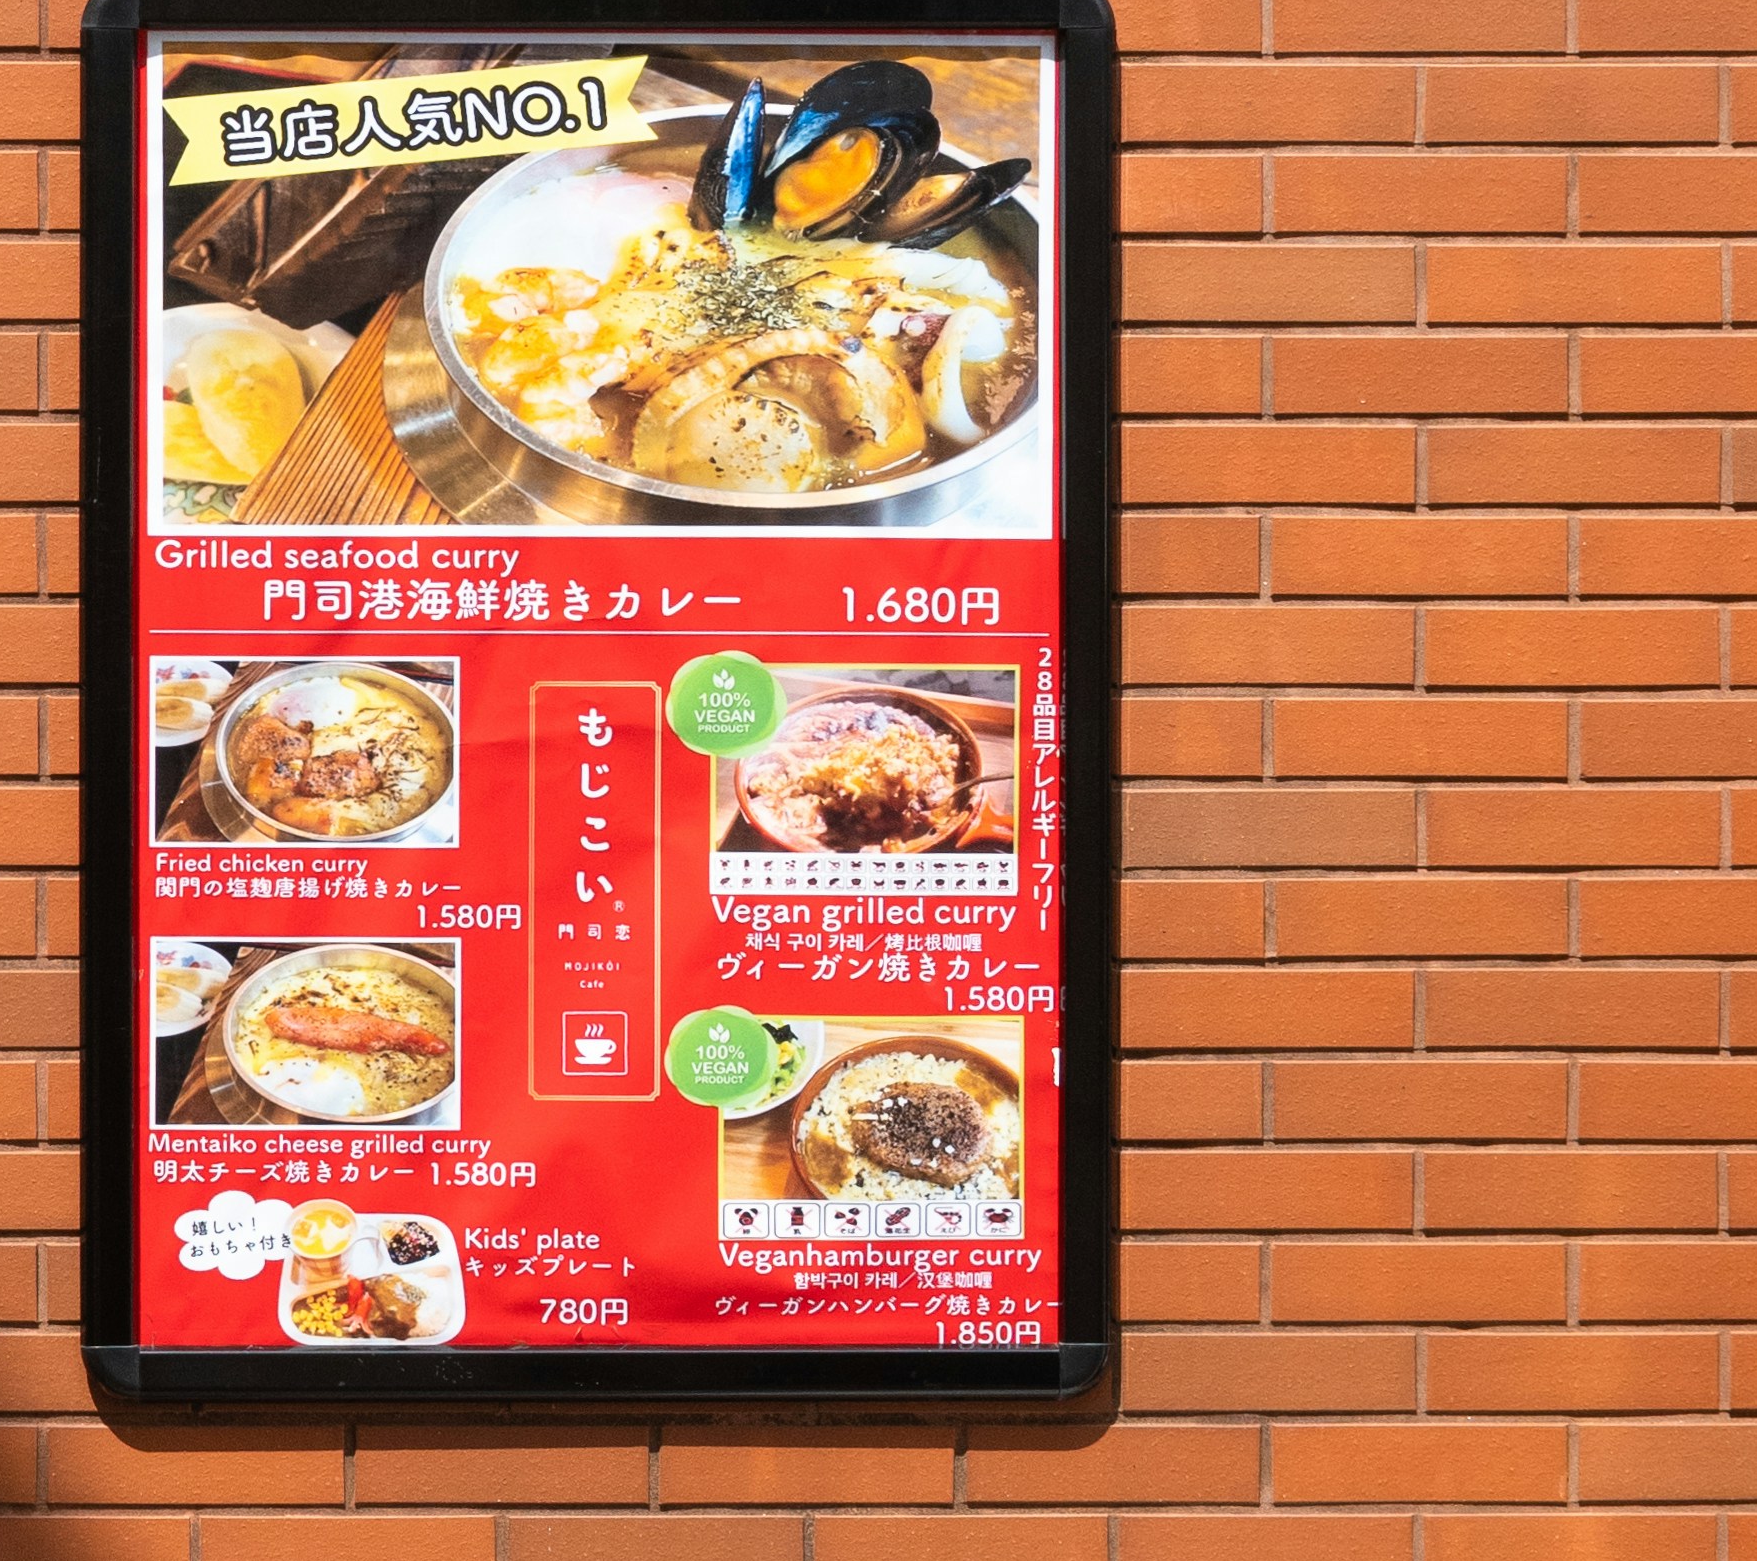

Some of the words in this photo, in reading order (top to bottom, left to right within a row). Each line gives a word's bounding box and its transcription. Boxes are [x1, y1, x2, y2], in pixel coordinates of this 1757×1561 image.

[221, 76, 608, 166] 当店人気NO.1
[154, 540, 273, 569] Grilled
[284, 540, 419, 570] seafood
[432, 546, 520, 578] curry
[264, 578, 741, 621] 門司港海鮮焼きカレー
[843, 587, 999, 625] 1.680円
[699, 692, 751, 708] 100%
[694, 709, 755, 723] VEGAN
[697, 724, 750, 733] PRODUCT
[1031, 647, 1058, 931] 28品目アレルギーフリー
[156, 853, 211, 872] Fried
[219, 854, 303, 872] chicken
[312, 859, 368, 876] curry
[418, 905, 521, 929] 1.580円
[712, 897, 811, 930] Vegan
[822, 896, 925, 931] grilled
[934, 902, 1017, 932] curry
[559, 924, 630, 940] 門司恋
[746, 933, 780, 951] 채식
[787, 933, 821, 951] 구이
[718, 951, 1039, 982] ヴィーガン焼きカレー
[580, 980, 604, 988] Cafe
[945, 986, 1053, 1012] 1.580円
[696, 1045, 745, 1060] 100%
[692, 1062, 749, 1074] VEGAN
[695, 1076, 744, 1084] PRODUCT
[149, 1133, 256, 1153] Mentaiko
[265, 1134, 343, 1153] cheese
[350, 1134, 423, 1159] grilled
[432, 1140, 491, 1159] curry
[154, 1160, 413, 1183] 明太チーズ焼きカレー
[431, 1162, 535, 1187] 1.580円
[191, 1234, 291, 1257] おもちゃ付き
[537, 1228, 599, 1255] plate
[466, 1256, 637, 1277] キッズプレート
[719, 1243, 959, 1273] Veganhamburger
[970, 1249, 1041, 1272] curry
[540, 1299, 627, 1325] 780円
[936, 1321, 1040, 1344] 1.850円
